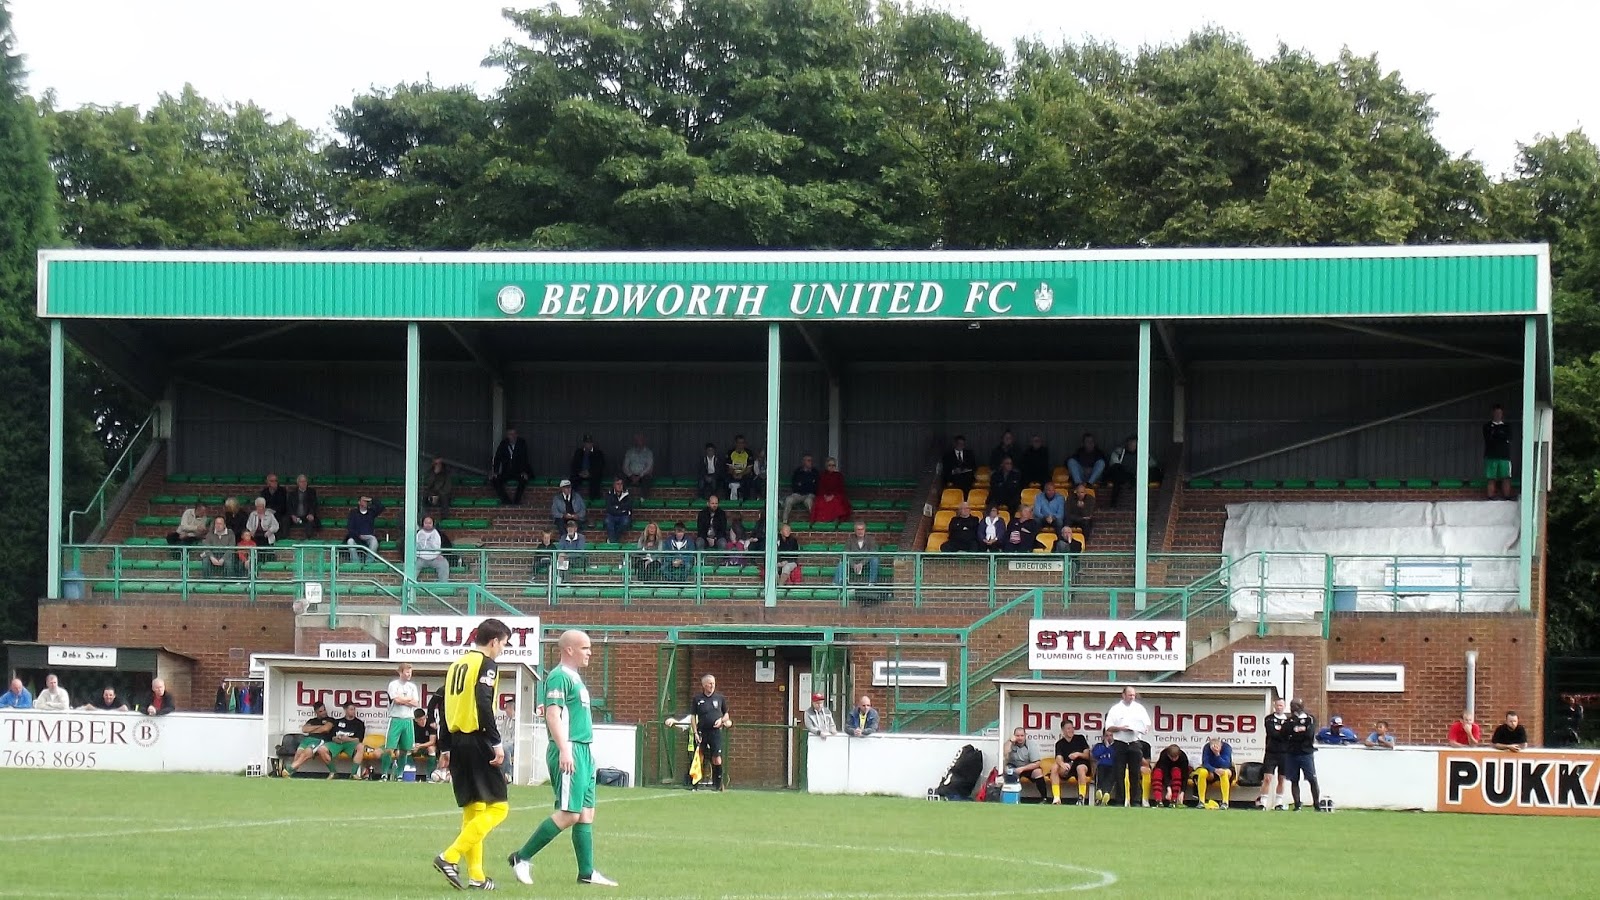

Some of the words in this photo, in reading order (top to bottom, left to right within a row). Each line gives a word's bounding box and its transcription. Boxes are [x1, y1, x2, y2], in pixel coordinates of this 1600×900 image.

[538, 283, 769, 316] BEDWORTH
[789, 281, 945, 314] UNITED
[963, 281, 1017, 313] FC
[1015, 562, 1052, 570] DIRECTORS
[1035, 630, 1181, 652] STUART
[325, 648, 357, 659] Toilets
[361, 649, 371, 659] at
[1036, 652, 1083, 660] PLUMBING
[1136, 653, 1179, 661] SUPPLIES
[1238, 655, 1271, 665] Toilets
[450, 663, 469, 696] 10
[1237, 667, 1247, 677] at
[1251, 669, 1271, 677] rear
[296, 680, 388, 709] brose
[1022, 703, 1103, 731] bros
[1154, 705, 1257, 733] brose
[4, 718, 128, 745] TIMBER
[1154, 735, 1188, 743] Technik
[1190, 735, 1202, 743] für
[4, 750, 46, 767] 7663
[53, 751, 97, 768] 8695
[1446, 757, 1600, 808] PUKK
